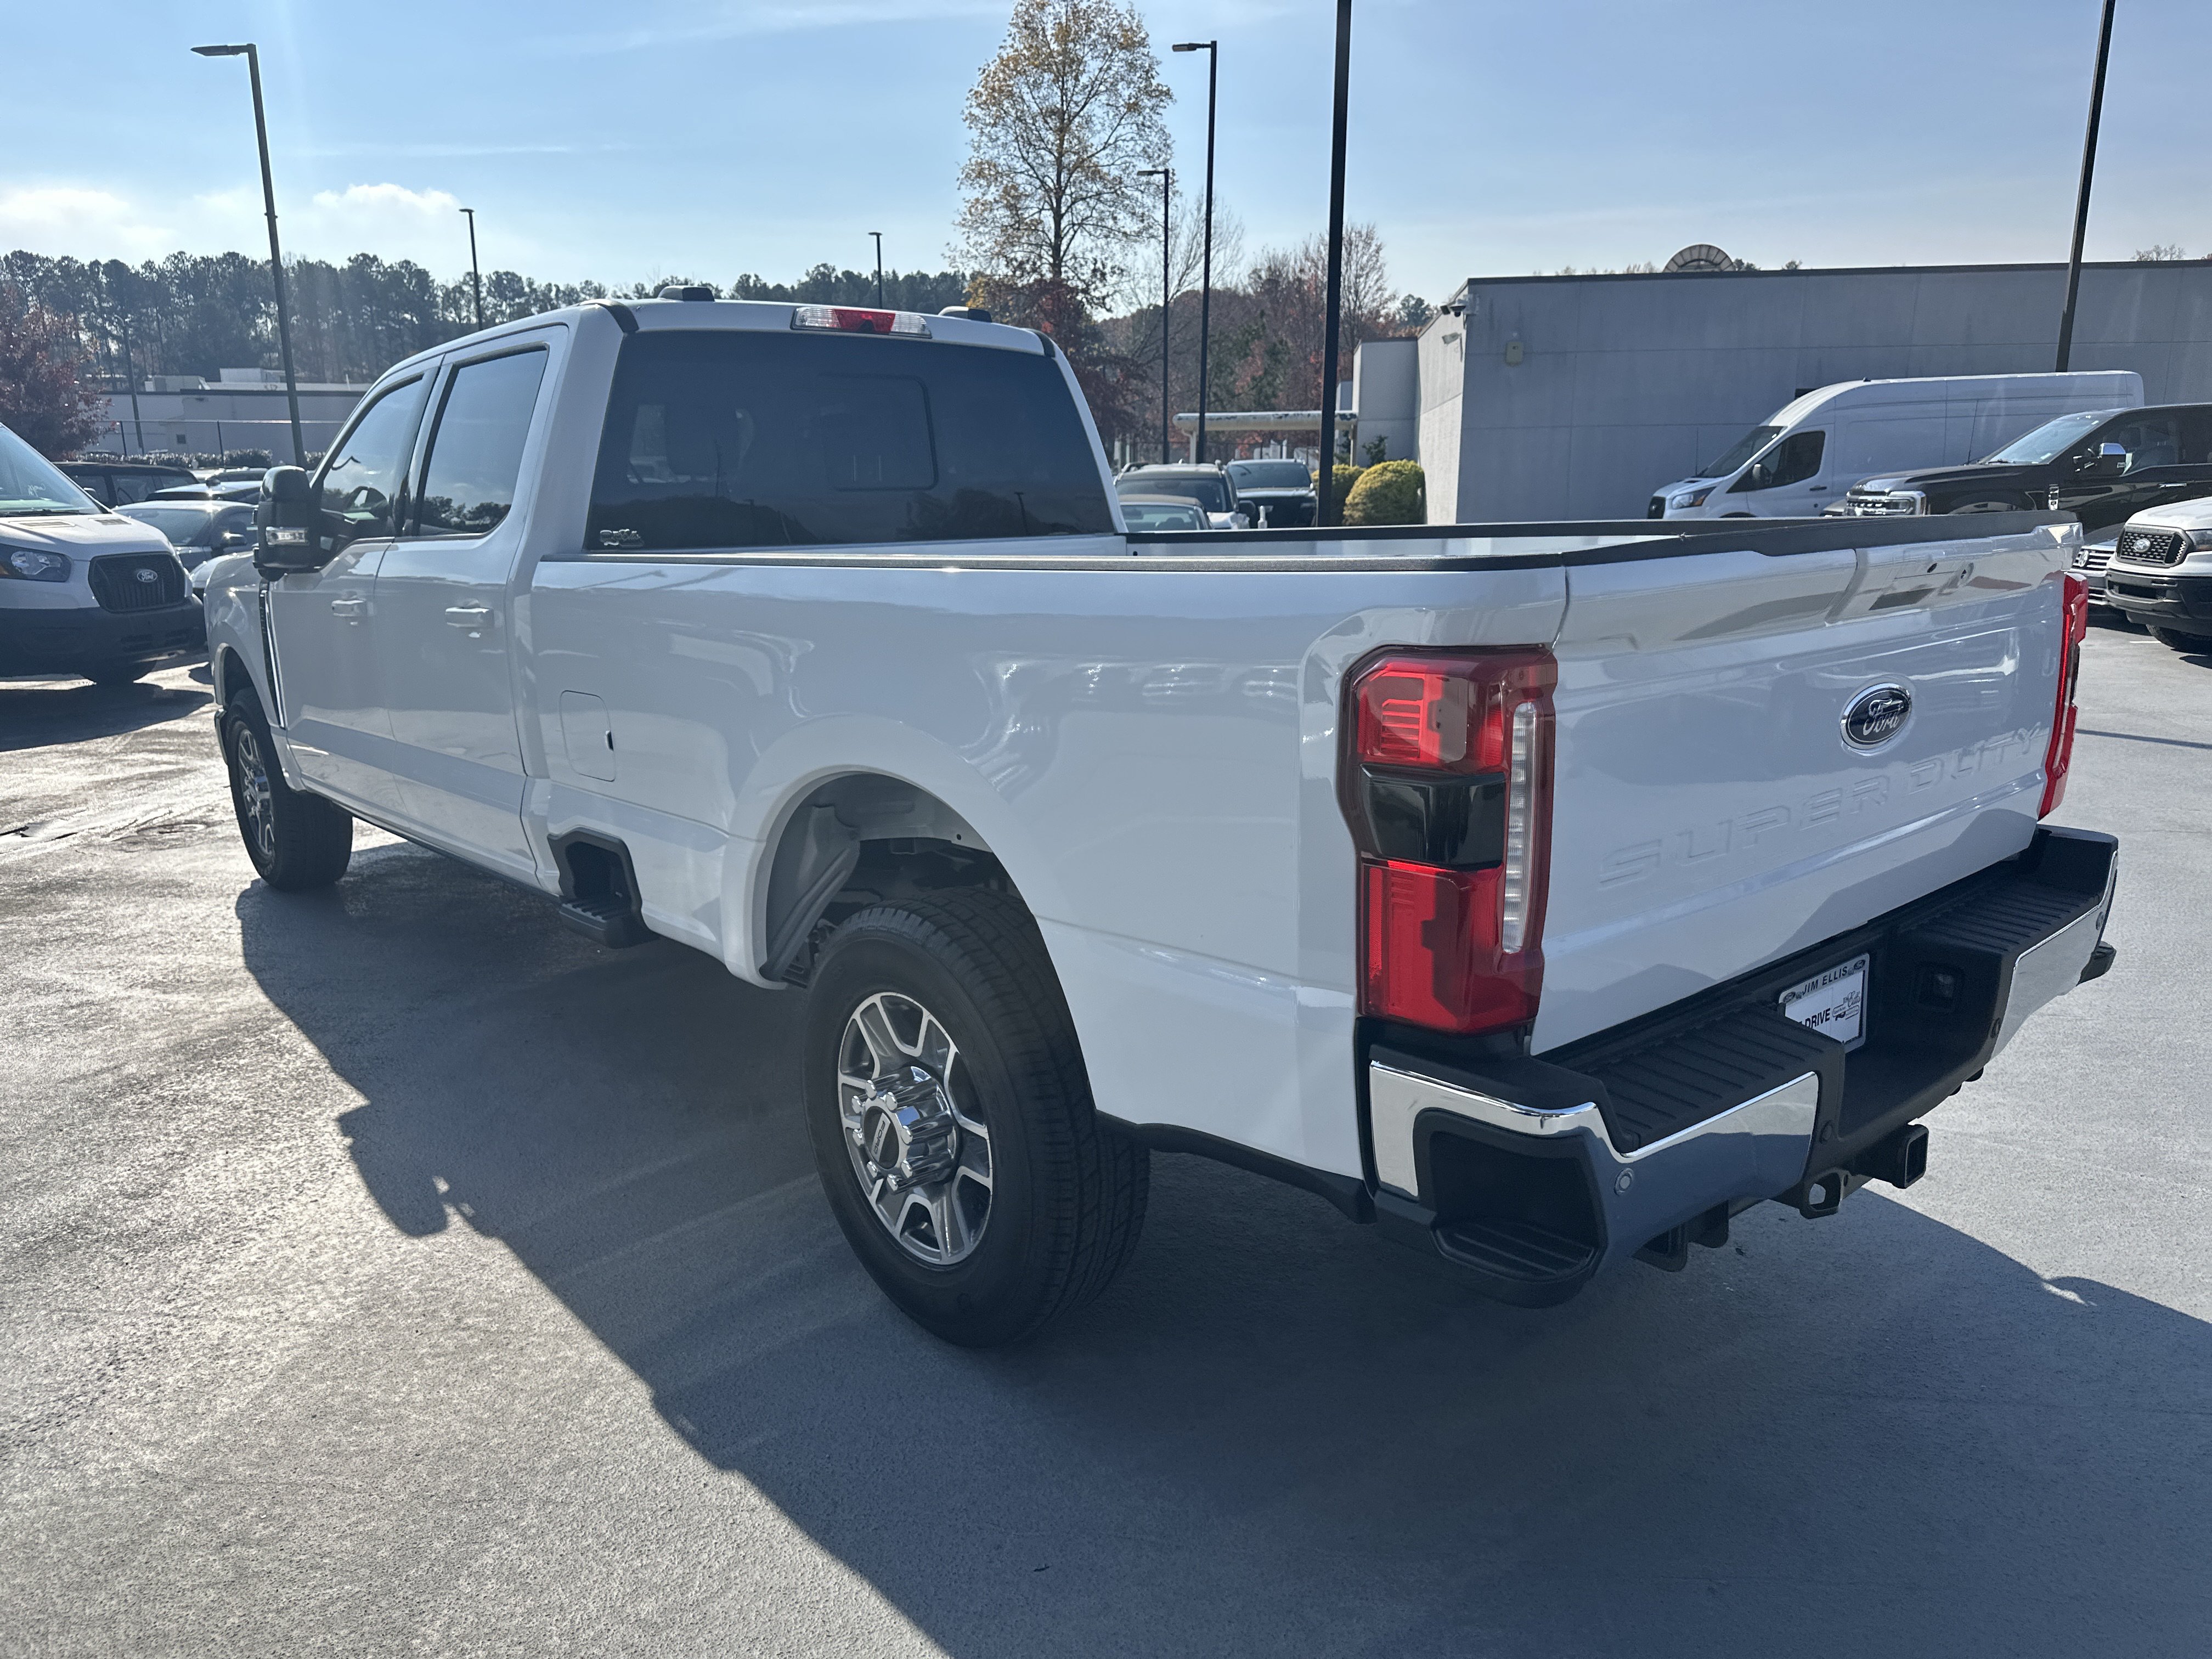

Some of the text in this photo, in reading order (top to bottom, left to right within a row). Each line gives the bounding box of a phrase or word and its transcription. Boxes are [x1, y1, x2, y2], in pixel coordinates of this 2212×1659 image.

[1863, 698, 1904, 736] Ford
[1597, 721, 2043, 890] SUPER DUTY
[1802, 966, 1848, 996] JIM ELLIS
[1804, 1007, 1831, 1029] DRIVE
[873, 1120, 886, 1155] FORD
